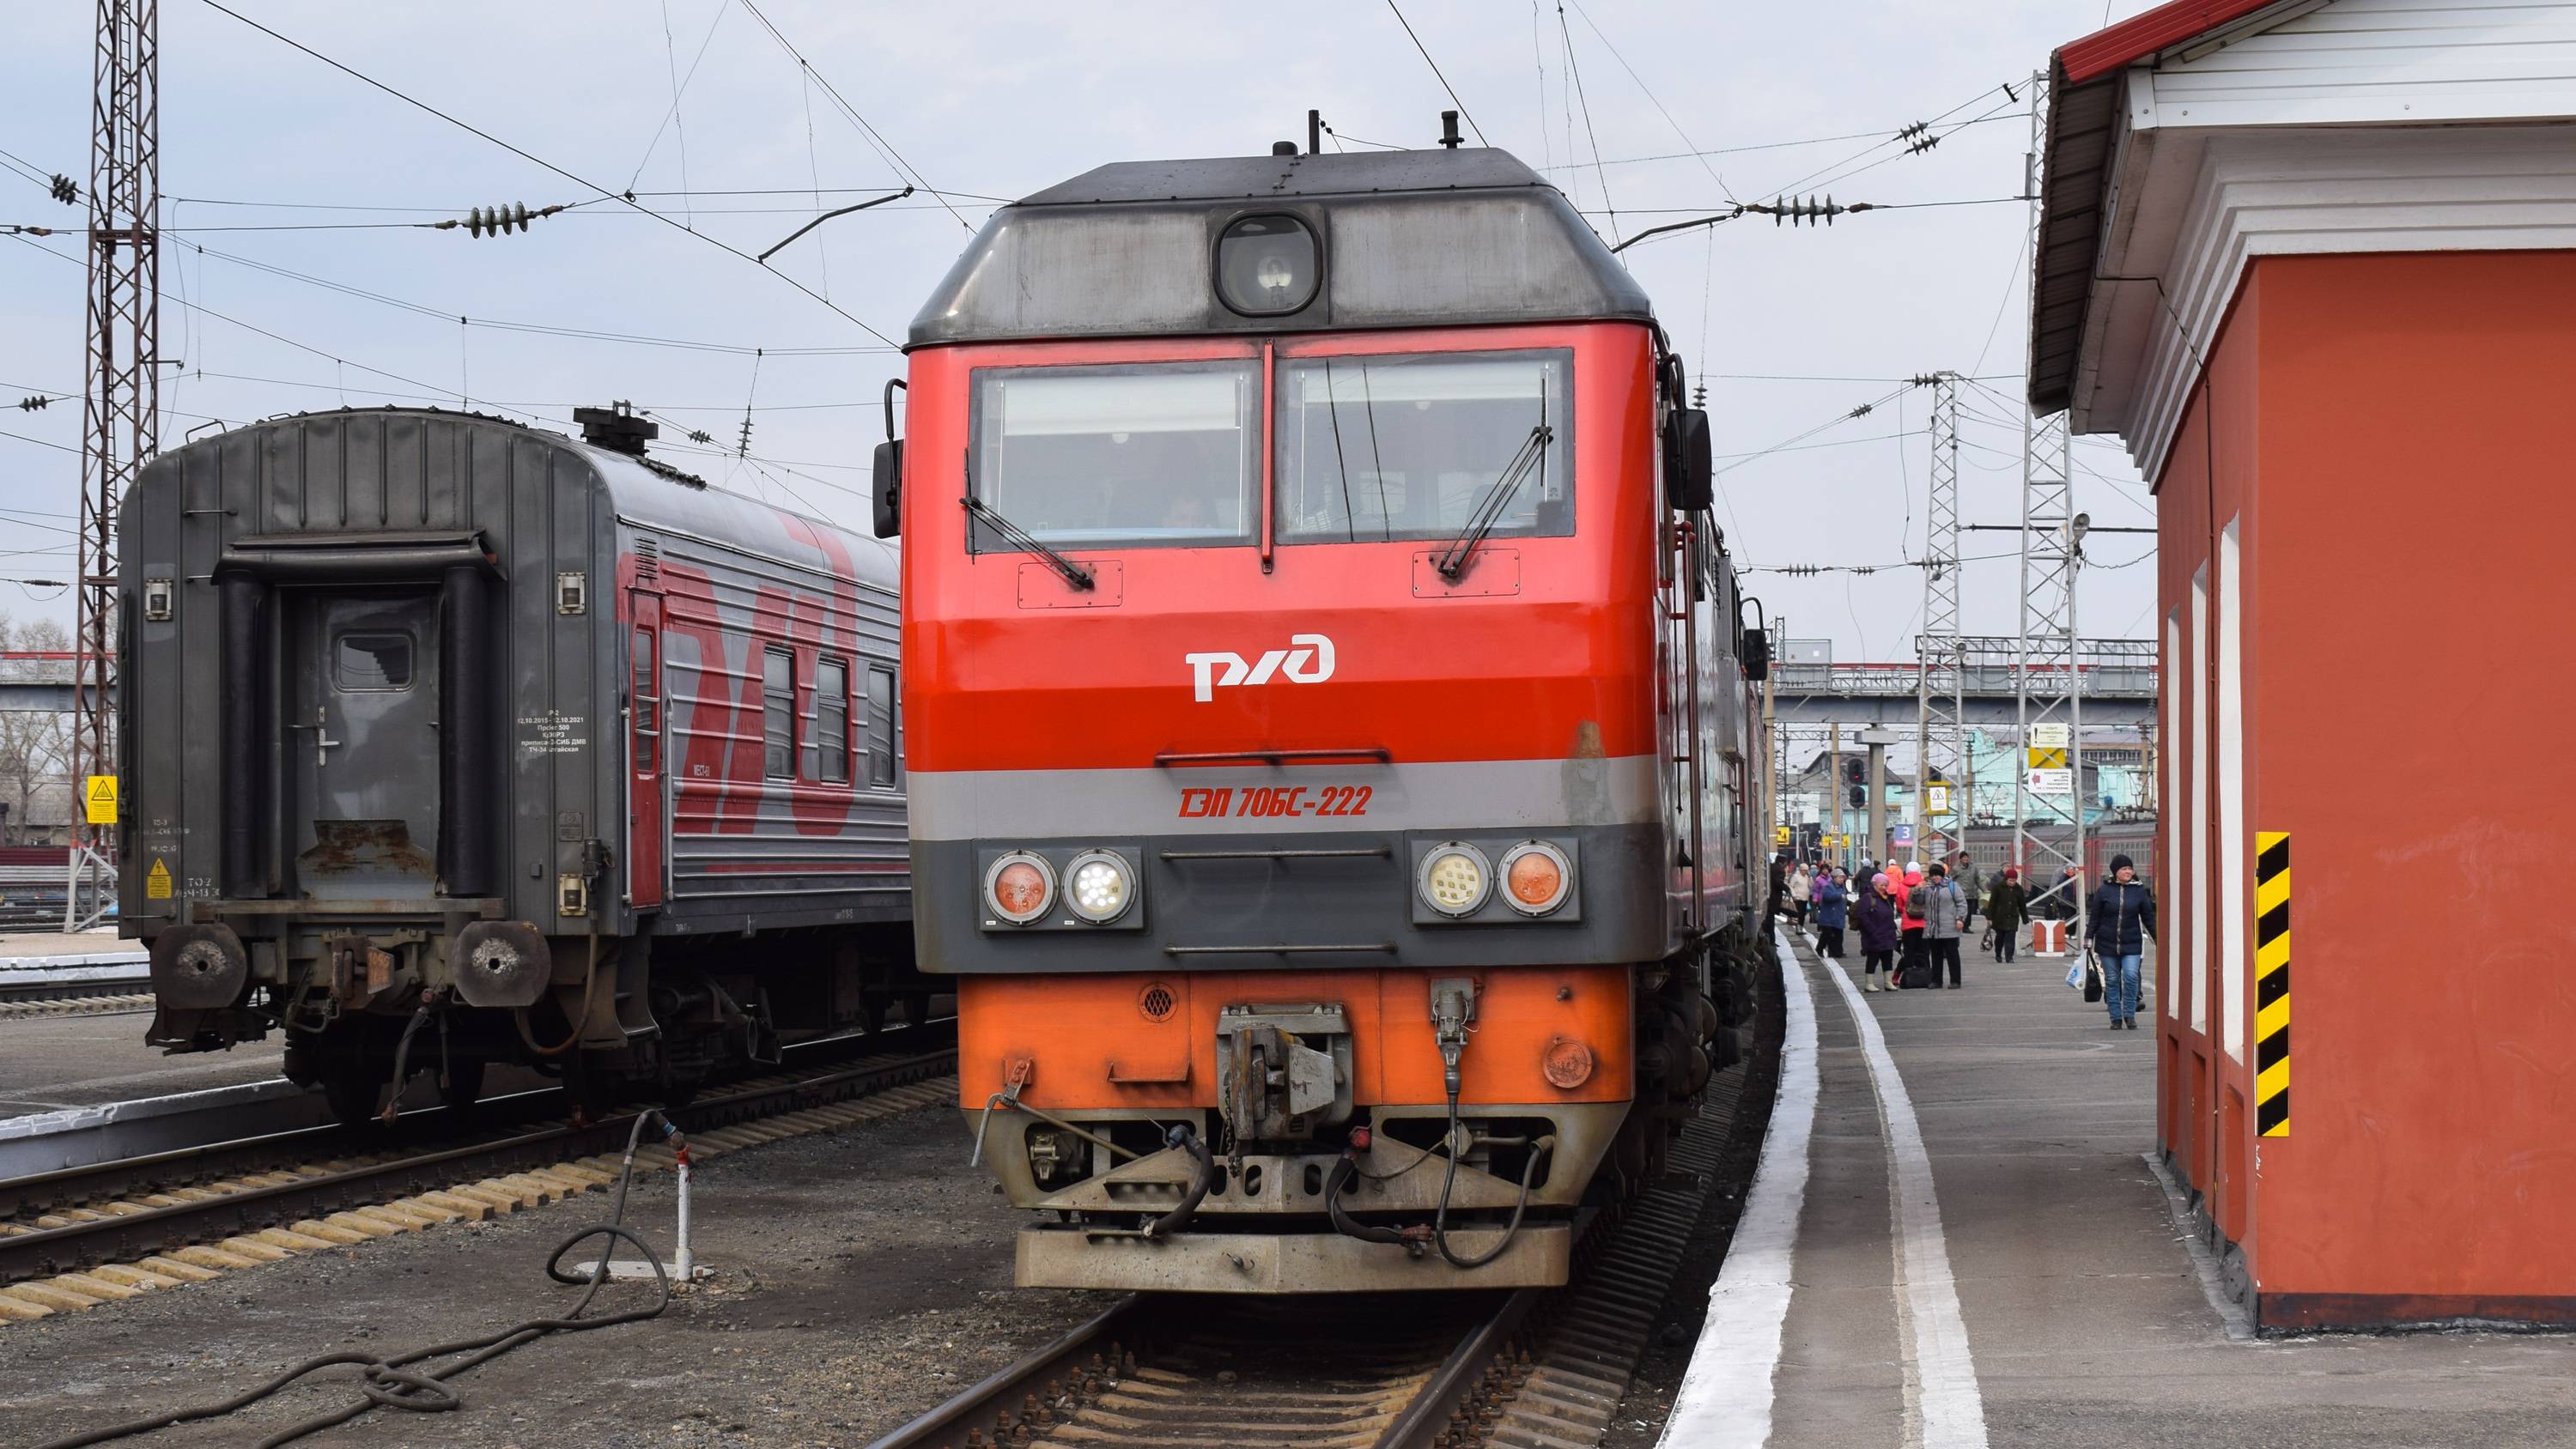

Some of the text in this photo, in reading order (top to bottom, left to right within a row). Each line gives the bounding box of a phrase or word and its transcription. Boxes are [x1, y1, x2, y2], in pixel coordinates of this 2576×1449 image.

[1178, 785, 1373, 818] ТЭП 70БС-222
[1902, 826, 1911, 839] 3
